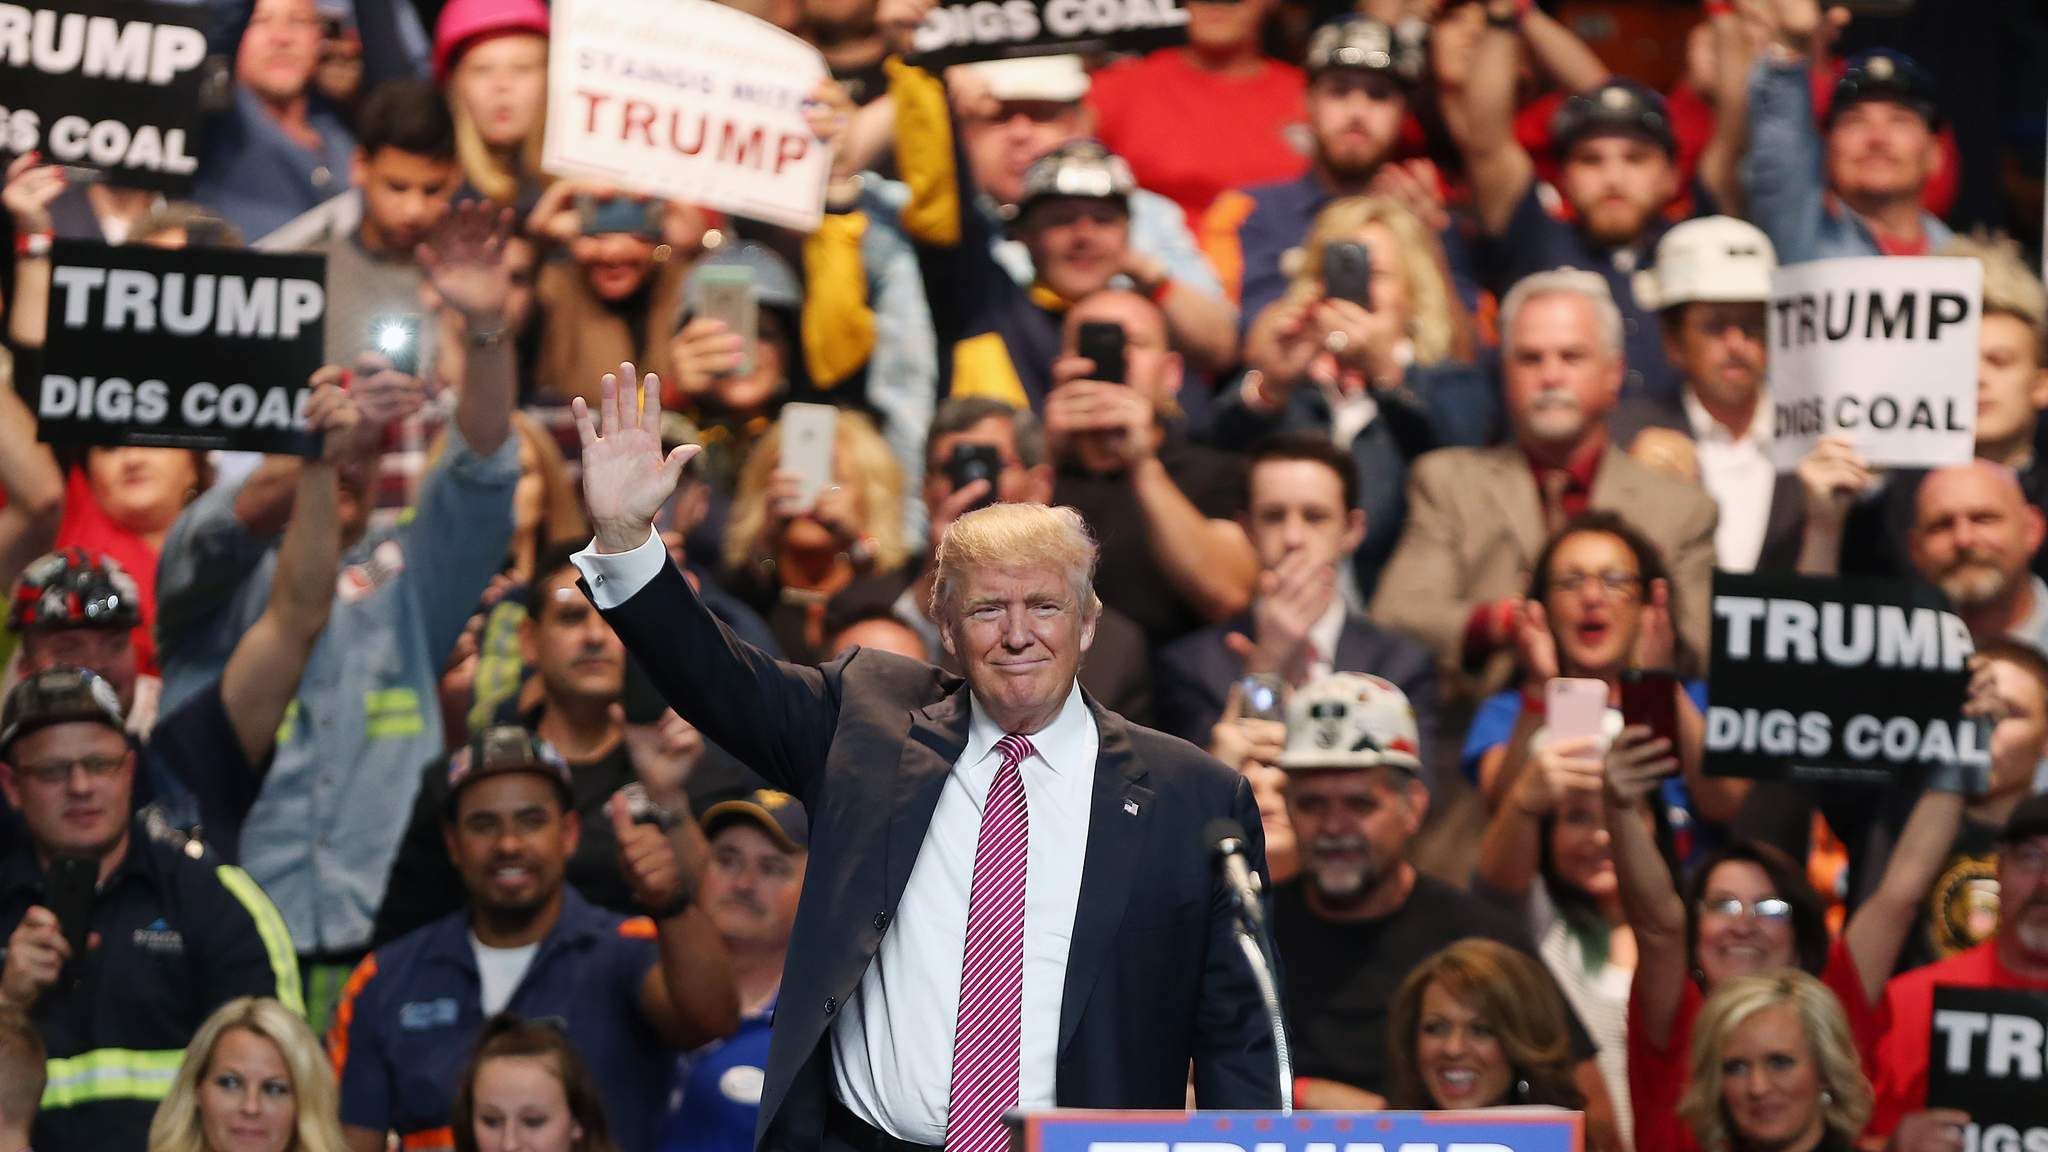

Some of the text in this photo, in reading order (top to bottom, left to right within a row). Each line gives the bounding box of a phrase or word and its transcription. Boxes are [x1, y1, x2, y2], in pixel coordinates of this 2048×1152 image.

[49, 115, 199, 175] COAL
[577, 88, 810, 175] TRUMP
[53, 265, 325, 340] TRUMP
[1776, 289, 1969, 349] TRUMP
[38, 374, 169, 424] DIGS
[1834, 395, 1967, 432] COAL
[1713, 595, 1976, 672] TRUMP
[1705, 705, 1991, 766] DIGS COAL
[1934, 1009, 2048, 1080] TR
